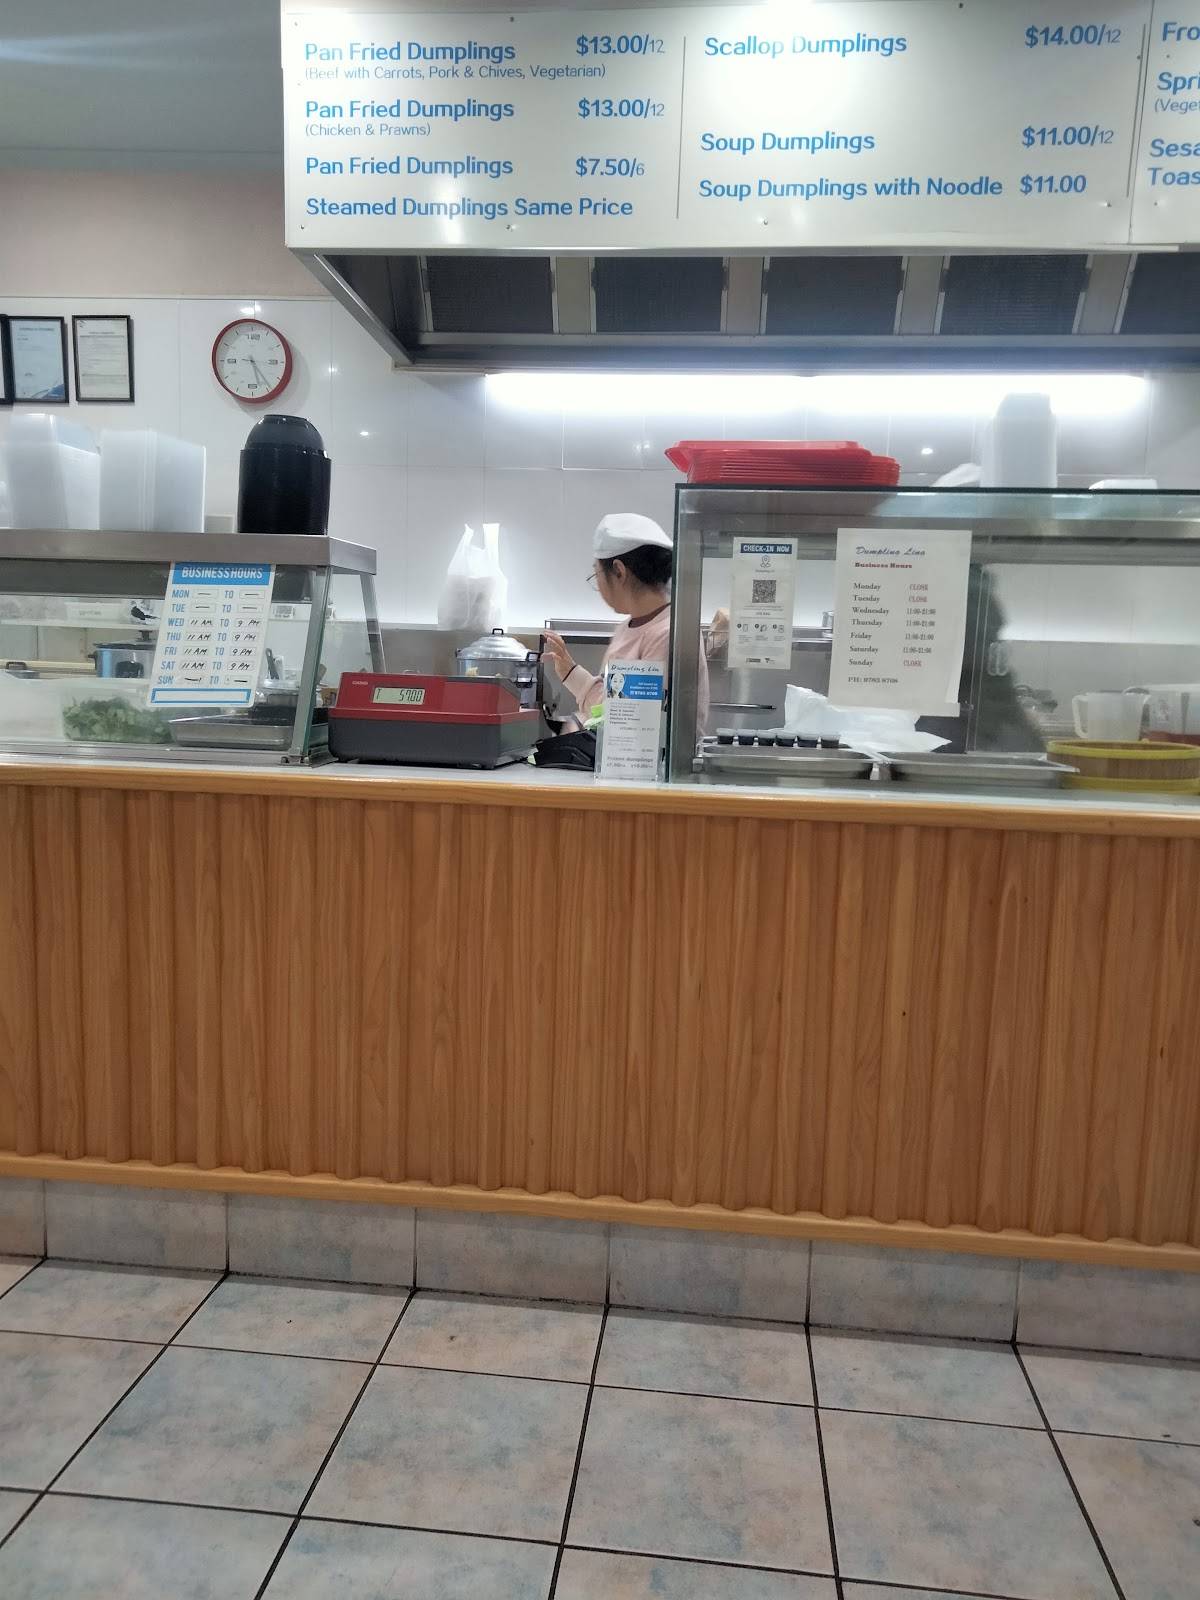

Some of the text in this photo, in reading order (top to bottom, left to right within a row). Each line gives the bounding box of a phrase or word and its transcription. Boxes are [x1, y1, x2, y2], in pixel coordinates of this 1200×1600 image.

[704, 24, 1121, 59] Scallop Dumplings $14.00/12
[305, 34, 665, 64] Pan Fried Dumplings $13.00/12
[305, 64, 606, 80] (Beef with Carrots, Pork & Chives, Vegetarian)
[305, 97, 665, 122] Pan Fried Dumplings $13.00/12
[305, 124, 432, 137] (Chicken & Prawns)
[700, 125, 1114, 155] Soup Dumplings $11.00/12
[305, 155, 645, 178] Pan Fried Dumplings $7.50/6
[699, 174, 1086, 201] Soup Dumplings with Noodle $11.00
[305, 197, 633, 221] Steamed Dumplings Same Price
[743, 544, 790, 553] CHECK-IN NOW
[181, 566, 263, 579] BUSINESS HOURS
[853, 582, 881, 591] Monday
[171, 589, 234, 599] MON TO
[853, 594, 880, 603] Tuesday
[171, 603, 232, 613] TUE TO
[852, 606, 890, 616] Wednesday
[167, 618, 184, 627] WED
[220, 618, 229, 627] TO
[248, 619, 261, 627] PM
[851, 618, 882, 628] Thursday
[166, 631, 181, 641] THU
[217, 632, 227, 641] TO
[244, 633, 256, 641] PM
[850, 631, 872, 640] Friday
[164, 646, 177, 656] FRI
[215, 647, 225, 656] TO
[240, 648, 253, 656] PM
[849, 645, 878, 656] Saturday
[161, 661, 176, 670] SAT
[212, 661, 222, 670] TO
[238, 662, 251, 670] PM
[848, 658, 873, 668] Sunday
[158, 675, 219, 684] SUN TO
